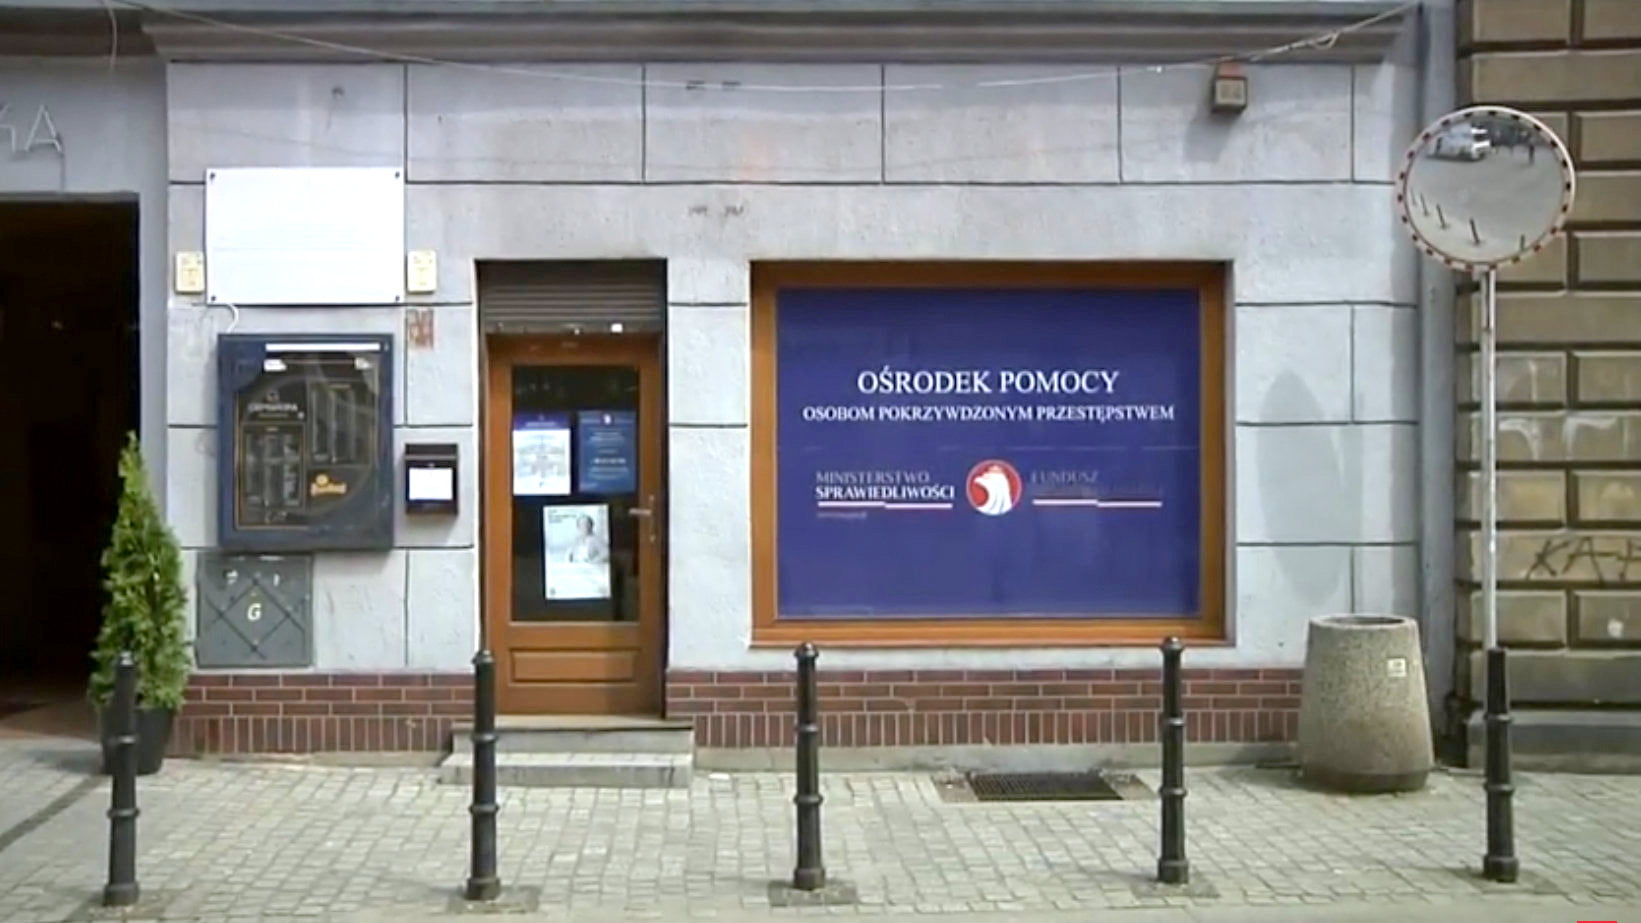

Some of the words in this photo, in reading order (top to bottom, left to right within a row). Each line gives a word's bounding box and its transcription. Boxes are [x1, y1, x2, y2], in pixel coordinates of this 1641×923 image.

[857, 365, 992, 394] OŚRODEK
[1000, 370, 1120, 394] POMOCY
[802, 405, 875, 421] OSOBOM
[878, 405, 1033, 421] POKRZYWDZONYM
[1036, 405, 1175, 423] PRZESTĘPSTWEM
[815, 470, 930, 484] MINISTERSTWO
[815, 483, 956, 500] SPRAWIEDLIWOŚCI
[247, 602, 262, 621] G
